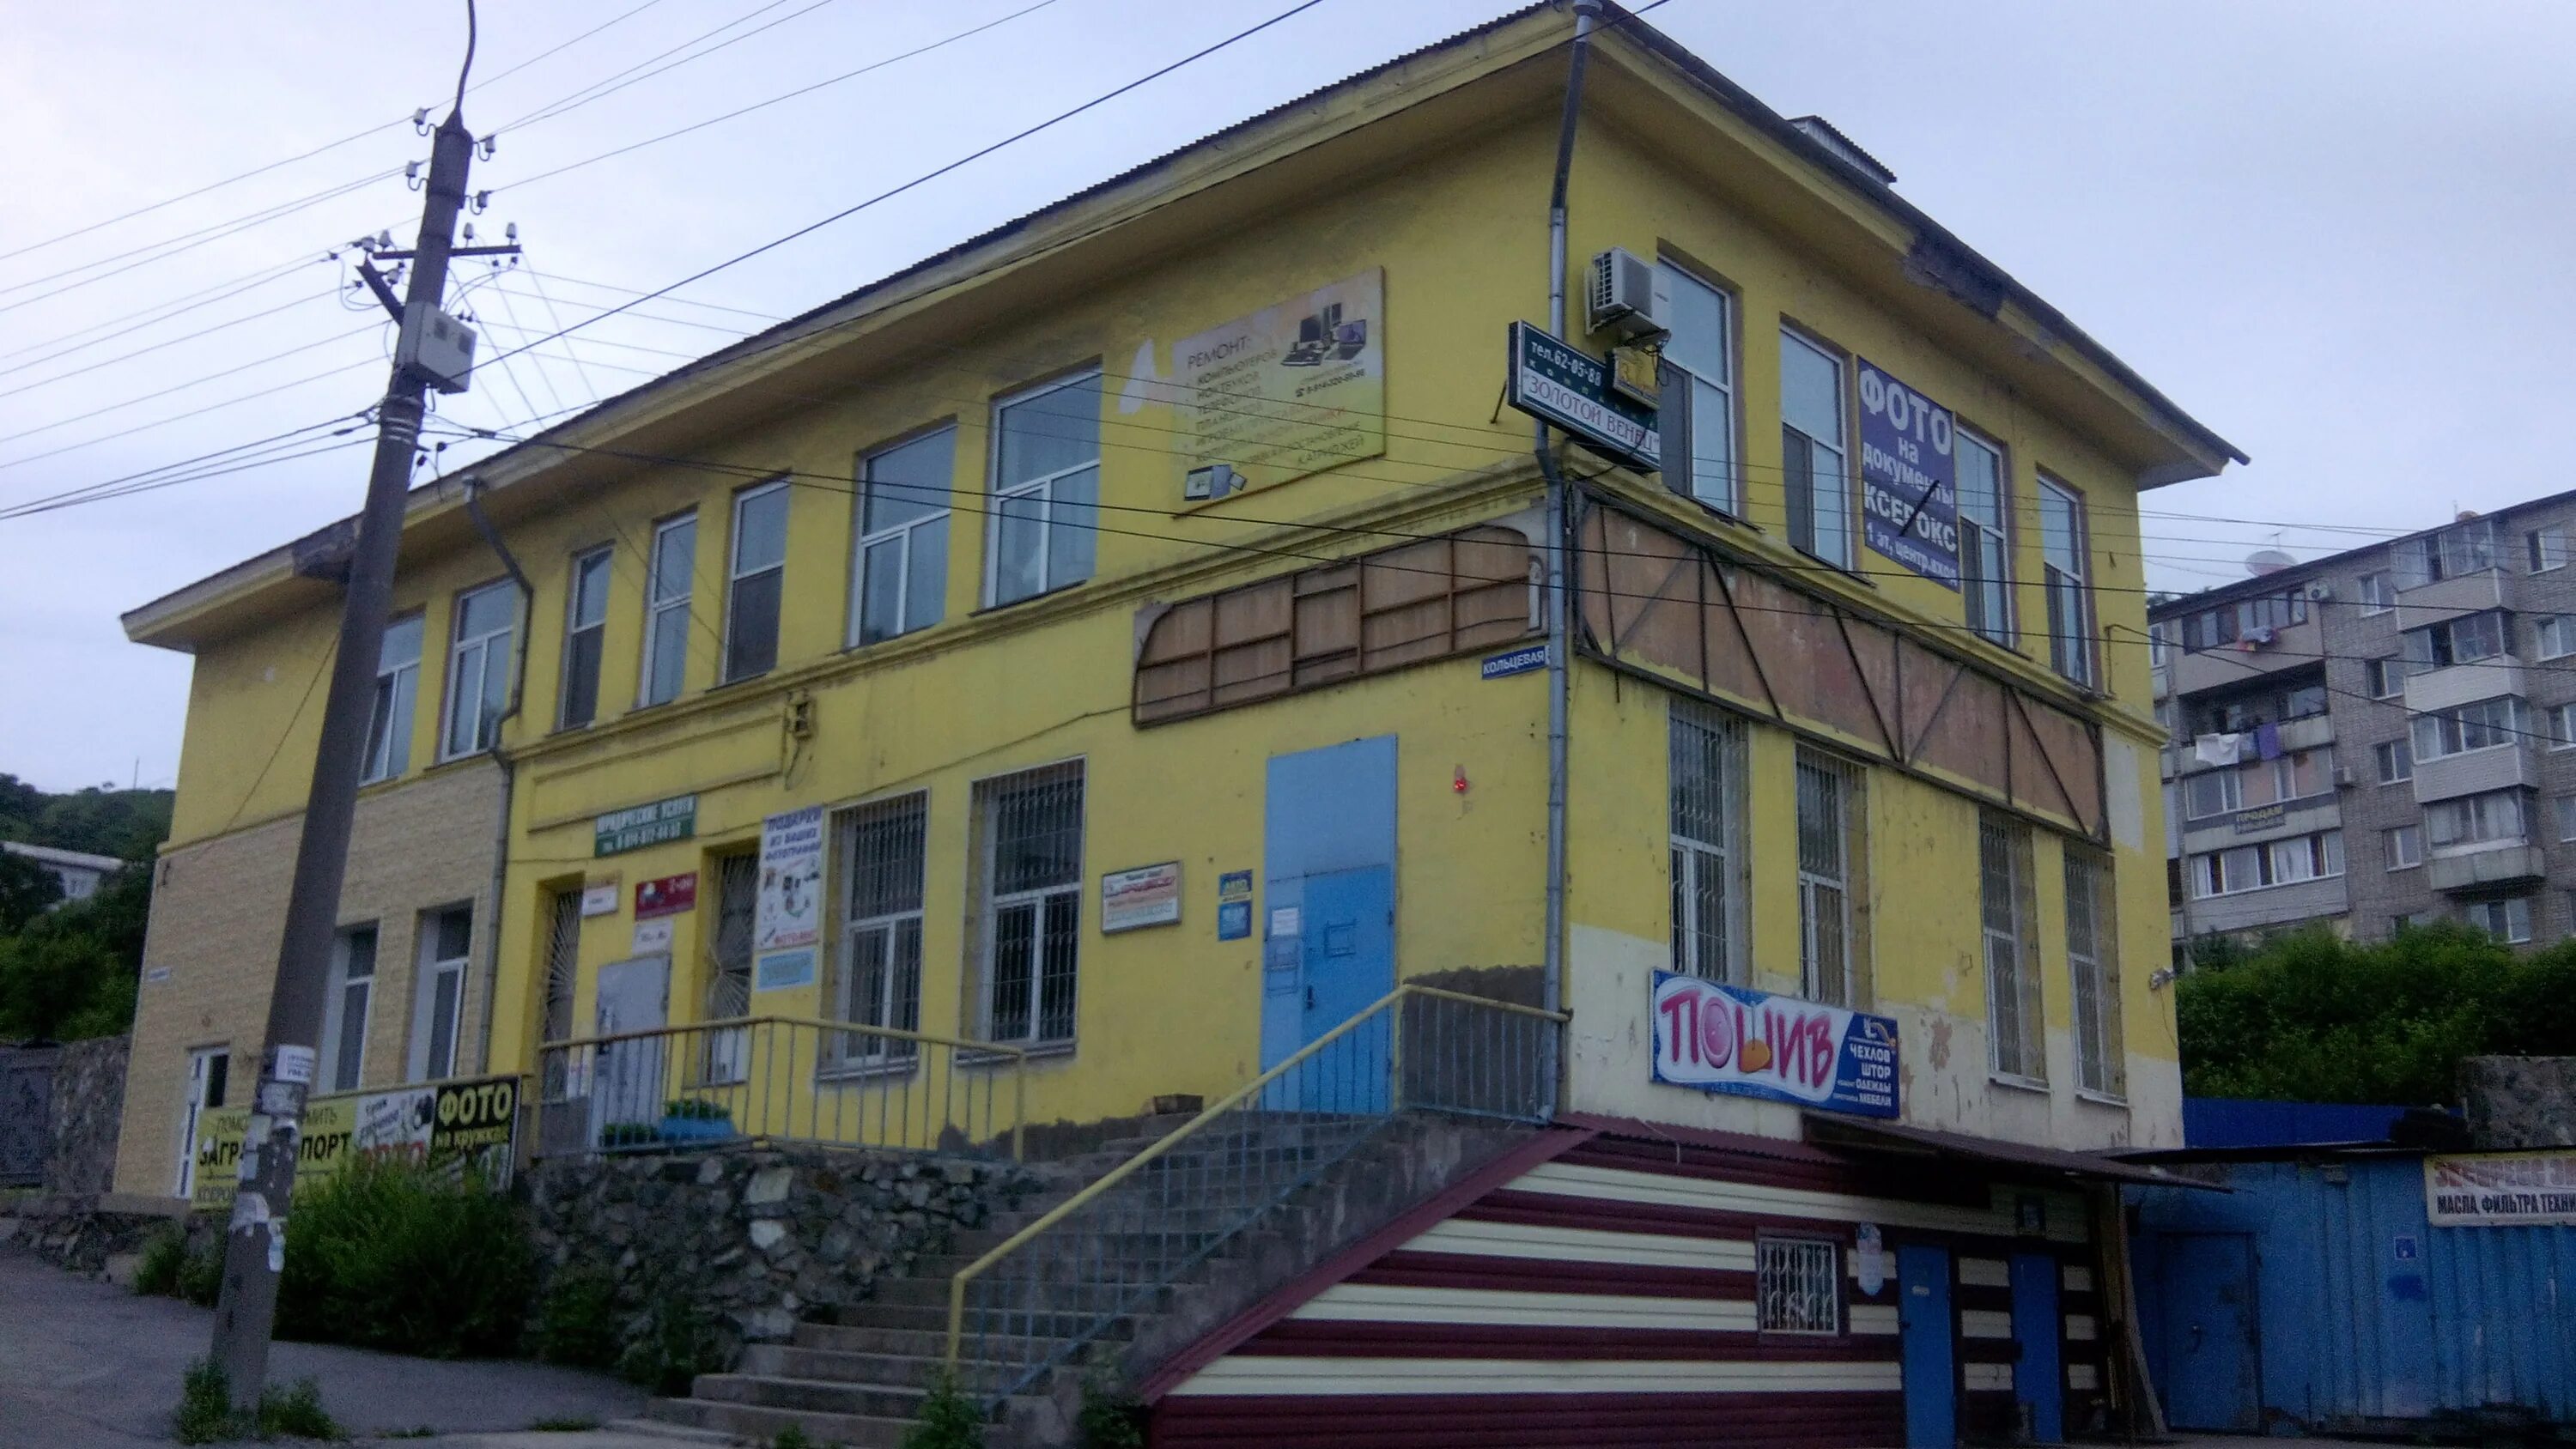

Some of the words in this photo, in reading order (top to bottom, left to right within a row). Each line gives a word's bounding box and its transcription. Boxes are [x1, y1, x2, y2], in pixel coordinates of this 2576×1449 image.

[1859, 368, 1953, 456] ФОТО
[1898, 436, 1920, 465] на
[1483, 650, 1545, 675] КОЛЬЦЕВАЯ
[1660, 988, 1835, 1089] ПОШИВ
[1850, 1043, 1891, 1064] ЧЕХЛОВ
[1861, 1063, 1892, 1080] ШТОР
[438, 1083, 513, 1127] ФОТО
[2437, 1194, 2481, 1216] МАСЛА,
[2481, 1193, 2540, 1215] ФИЛЬТРА
